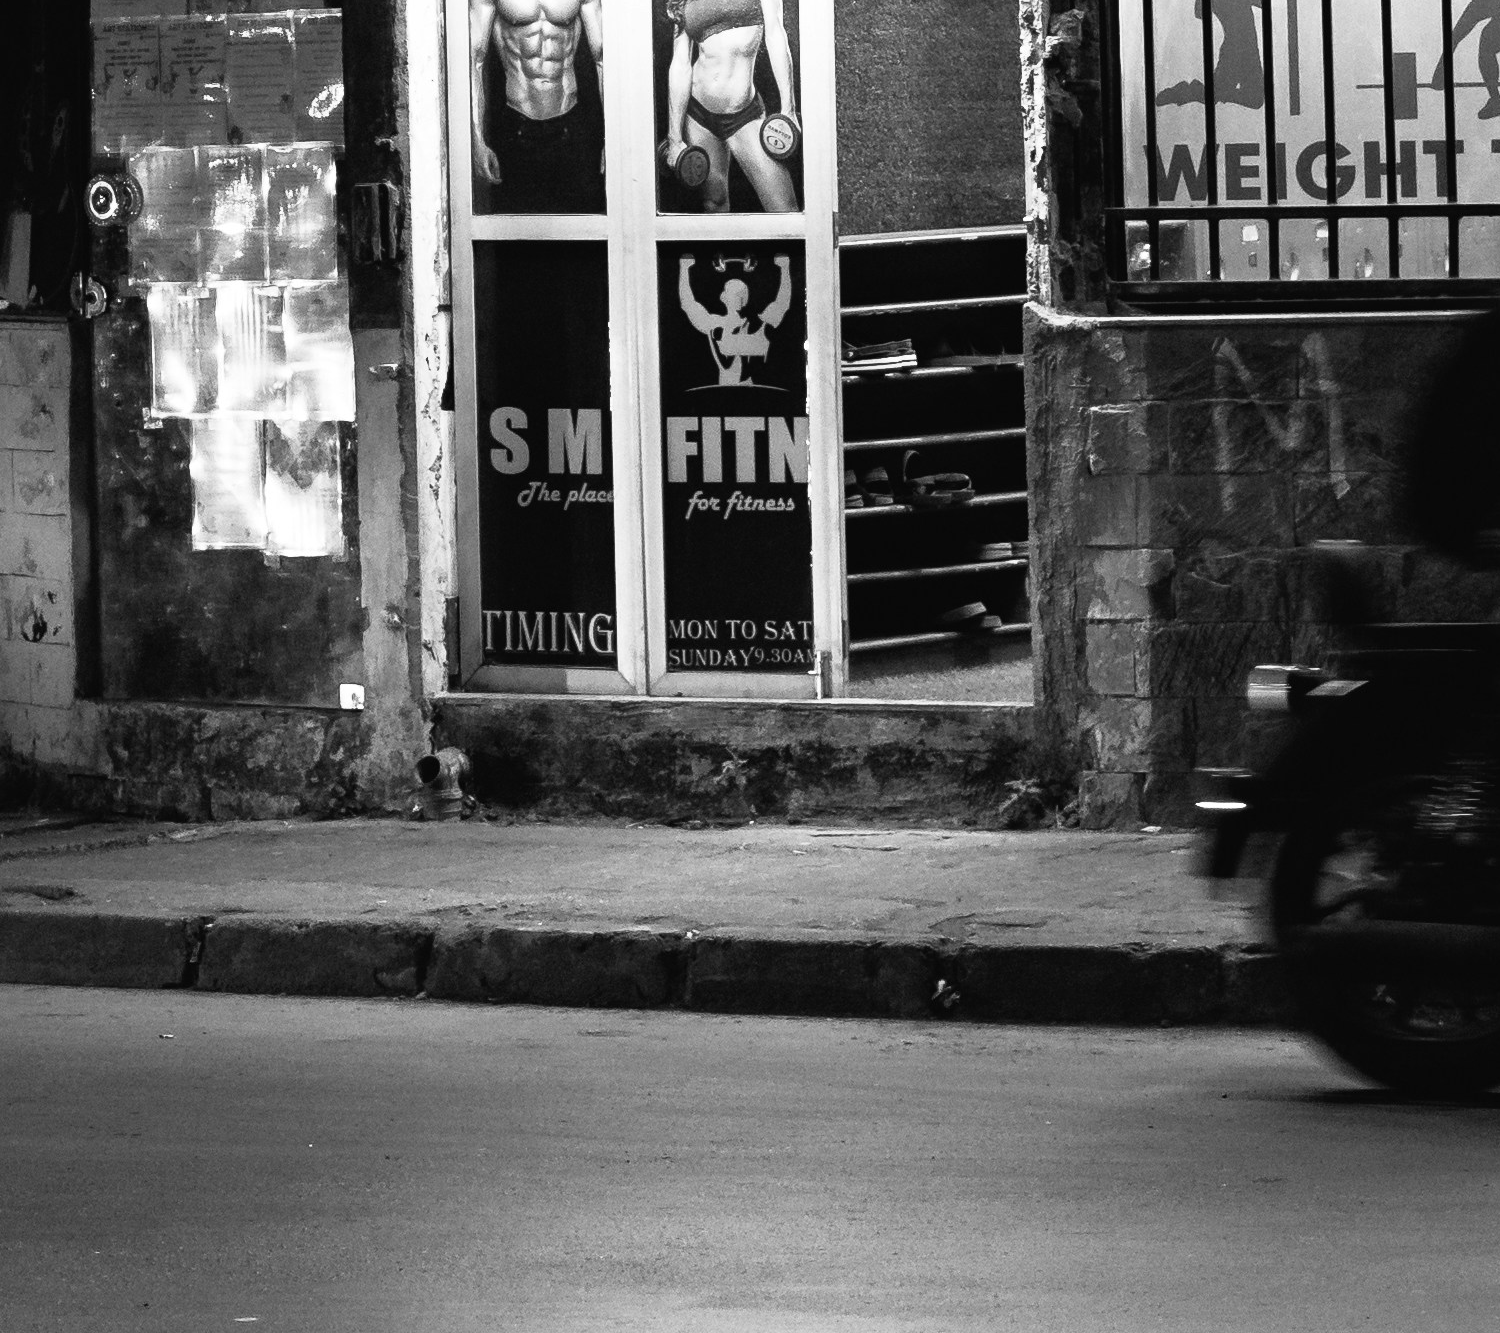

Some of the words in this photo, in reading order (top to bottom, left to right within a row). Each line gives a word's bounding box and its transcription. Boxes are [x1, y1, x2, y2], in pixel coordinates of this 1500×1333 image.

[1144, 137, 1466, 205] WEIGHT
[489, 405, 531, 475] S
[547, 407, 603, 475] M
[666, 415, 809, 483] FITN
[518, 482, 562, 507] The
[686, 491, 721, 520] for
[723, 491, 796, 520] fitness
[482, 609, 615, 654] TIMING
[669, 619, 719, 640] MON
[725, 619, 756, 640] TO
[763, 620, 813, 641] SAT
